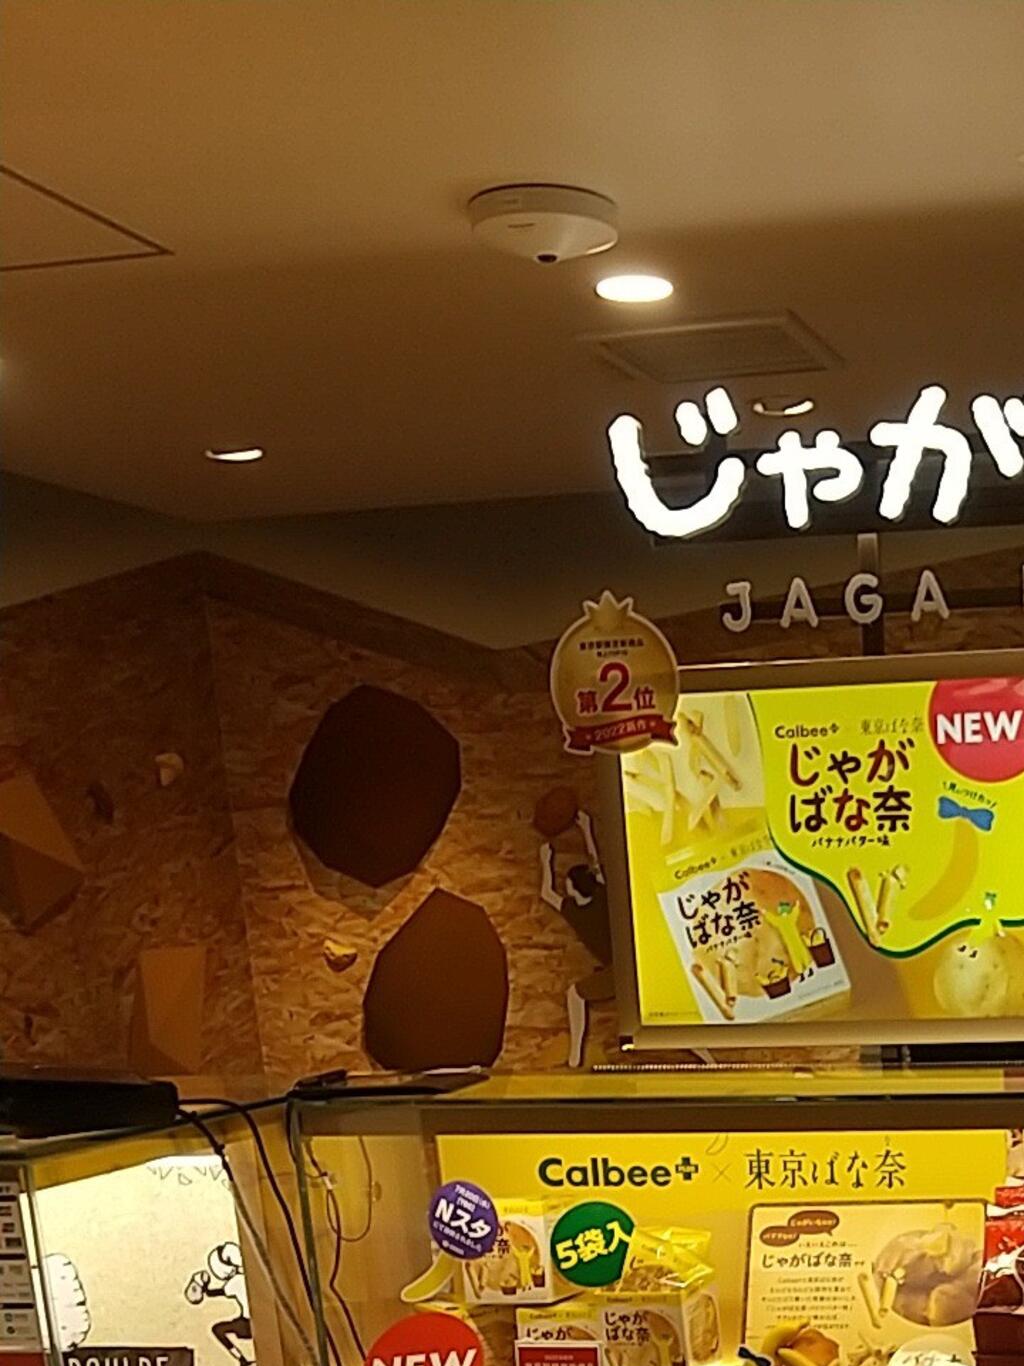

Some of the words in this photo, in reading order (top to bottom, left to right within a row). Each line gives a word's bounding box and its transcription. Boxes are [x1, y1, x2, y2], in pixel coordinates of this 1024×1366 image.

[721, 570, 950, 632] JAGA
[577, 661, 656, 713] 第2位
[937, 710, 1023, 745] NEW
[789, 738, 915, 787] じゃが
[789, 784, 912, 833] ばな奈
[811, 834, 891, 849] バナナバター味
[677, 871, 749, 921] じゃが
[685, 901, 762, 949] ばな奈
[744, 1147, 907, 1189] 東京ばな奈
[435, 1198, 491, 1238] Nスタ
